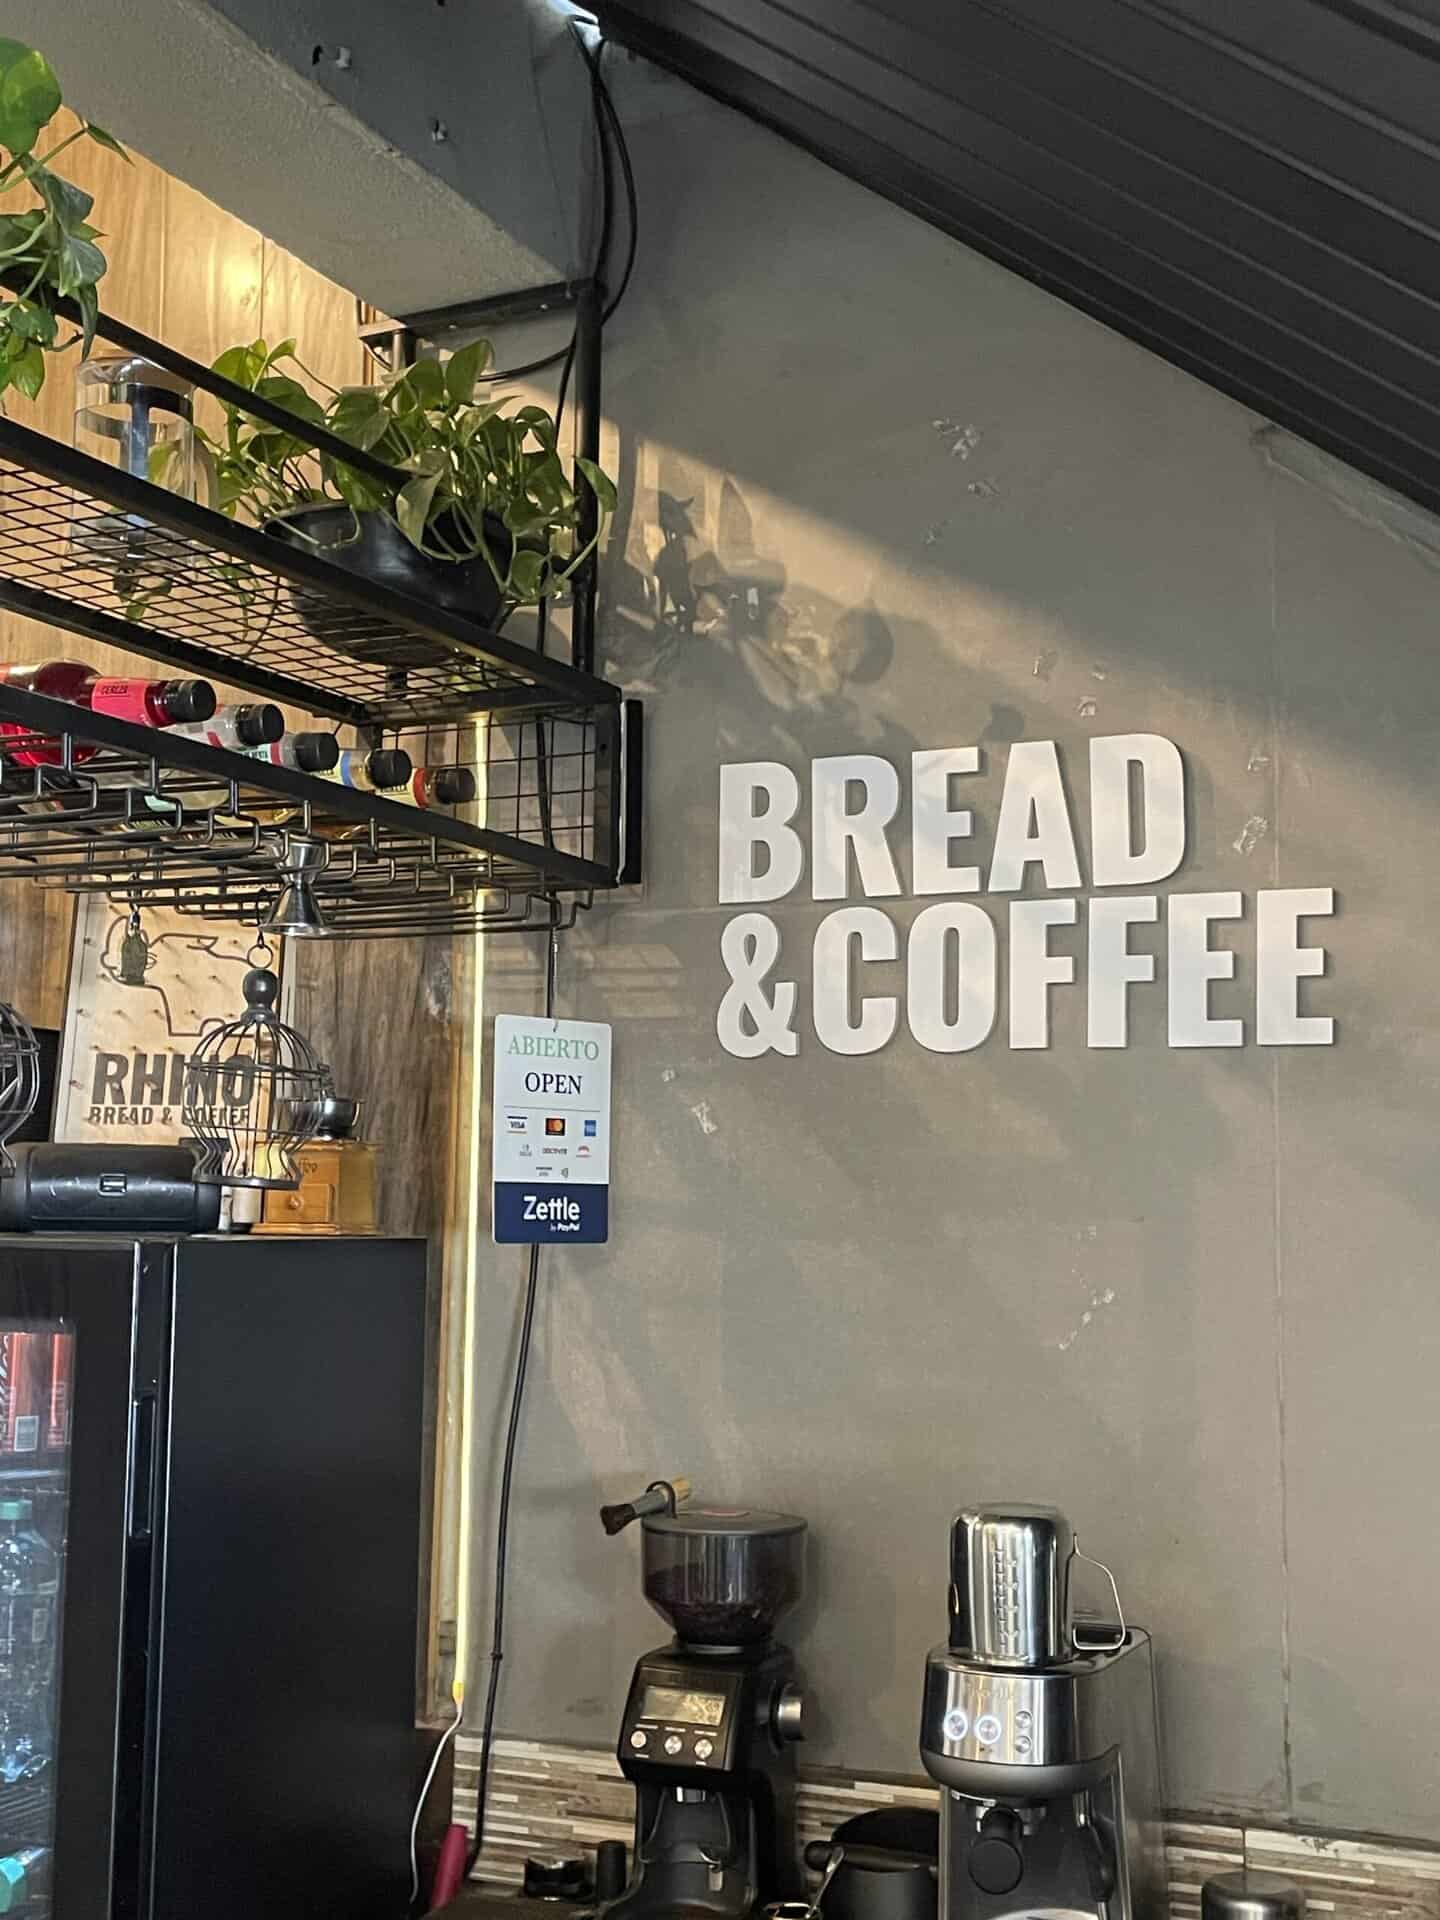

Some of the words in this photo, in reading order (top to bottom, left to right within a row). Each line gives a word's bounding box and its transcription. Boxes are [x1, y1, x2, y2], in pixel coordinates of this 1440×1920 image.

[718, 733, 1185, 904] BREAD
[507, 1034, 600, 1061] ABIERTO
[91, 1053, 254, 1106] RHINO
[525, 1072, 582, 1095] OPEN
[88, 1106, 153, 1125] BREAD
[161, 1107, 172, 1125] &
[510, 1120, 525, 1129] VISA
[523, 1195, 580, 1221] Zettle
[557, 1223, 580, 1231] PayPal
